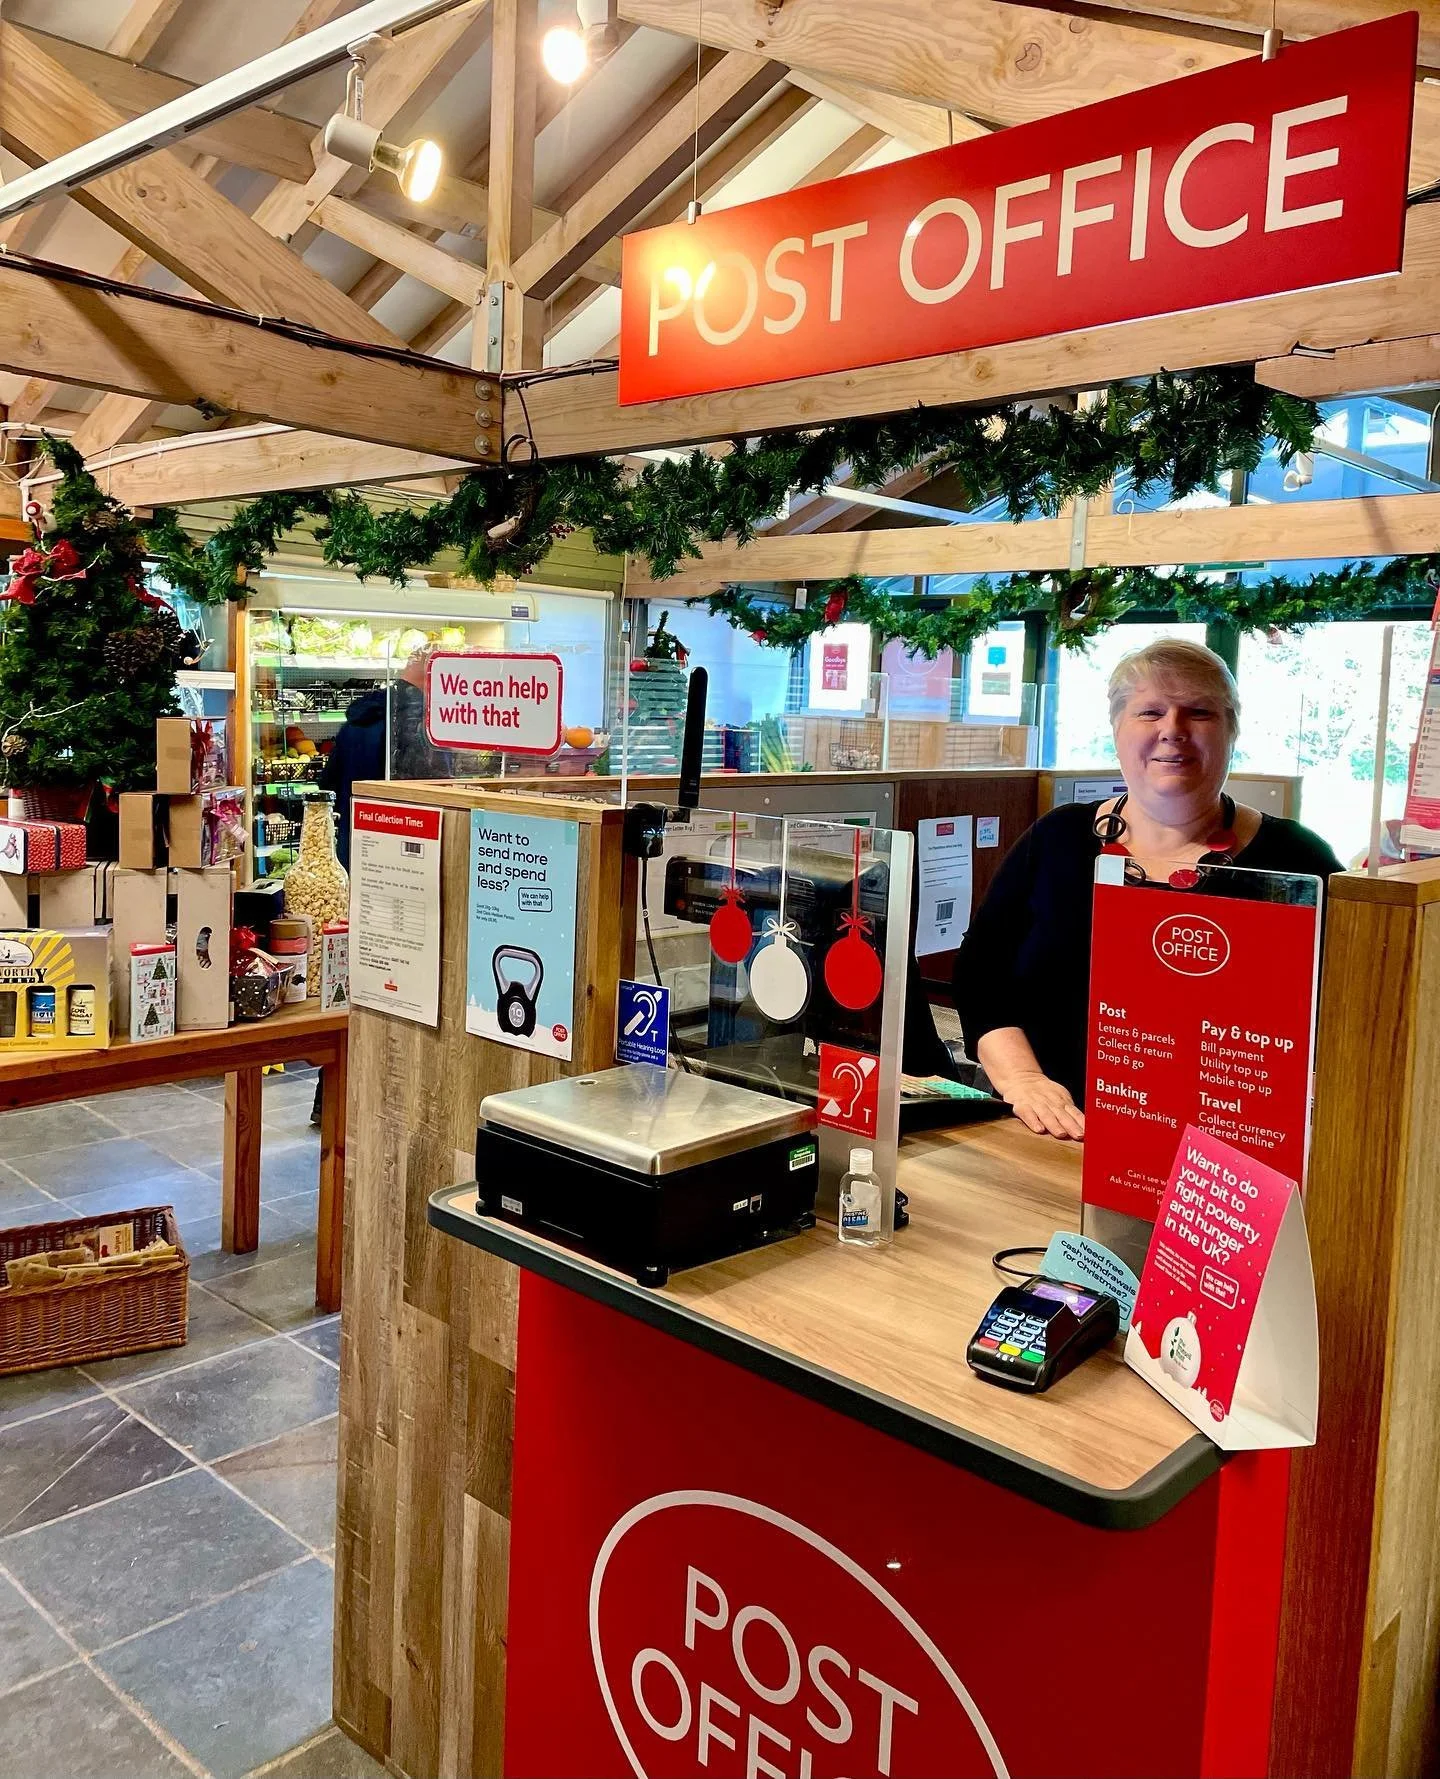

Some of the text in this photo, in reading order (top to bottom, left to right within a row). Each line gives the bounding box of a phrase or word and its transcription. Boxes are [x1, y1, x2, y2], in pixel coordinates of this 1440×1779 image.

[648, 95, 1348, 358] POST OFFICE
[440, 673, 549, 705] We can help
[439, 702, 520, 728] with that
[359, 811, 424, 828] Final Collection Times
[478, 827, 530, 847] Want to
[478, 846, 548, 866] send more
[477, 862, 547, 882] and spend
[477, 875, 510, 892] less?
[533, 899, 543, 907] that
[538, 893, 549, 901] help
[1172, 926, 1213, 945] POST
[1161, 941, 1219, 962] OFFICE
[0, 968, 48, 984] ORTHY
[511, 1006, 523, 1018] 10
[1099, 1002, 1127, 1019] Post
[650, 1030, 659, 1043] T
[1098, 1021, 1176, 1045] Letters & parcels
[1201, 1020, 1294, 1053] Pay & top up
[618, 1038, 636, 1049] Portable
[636, 1042, 654, 1054] Hearing
[654, 1047, 666, 1057] Loop
[1098, 1036, 1173, 1060] Collect & return
[1200, 1041, 1265, 1063] Bill payment
[1097, 1050, 1145, 1070] Drop & go
[1200, 1056, 1269, 1079] Utility top up
[1096, 1078, 1148, 1106] Banking
[1199, 1071, 1272, 1097] Mobile top up
[1095, 1098, 1178, 1129] Everyday banking
[1199, 1091, 1242, 1114] Travel
[863, 1107, 872, 1124] T
[1198, 1124, 1275, 1148] ordered online
[1199, 1112, 1286, 1143] Collect currency
[1127, 1169, 1146, 1181] Can't
[1147, 1176, 1159, 1184] see
[1186, 1146, 1259, 1199] Want to do
[1109, 1175, 1123, 1185] Ask
[1141, 1184, 1156, 1194] visit
[1178, 1165, 1246, 1213] your bit to
[1174, 1181, 1260, 1245] fight poverty
[1169, 1200, 1245, 1254] and hunger
[1164, 1213, 1231, 1266] in the UK?
[1061, 1239, 1083, 1259] cash
[1083, 1255, 1137, 1297] withdrawals
[1079, 1241, 1124, 1277] Need free
[1062, 1250, 1076, 1262] for
[1076, 1260, 1128, 1299] Christmas?
[684, 1564, 919, 1778] POST
[631, 1648, 856, 1779] OFF
